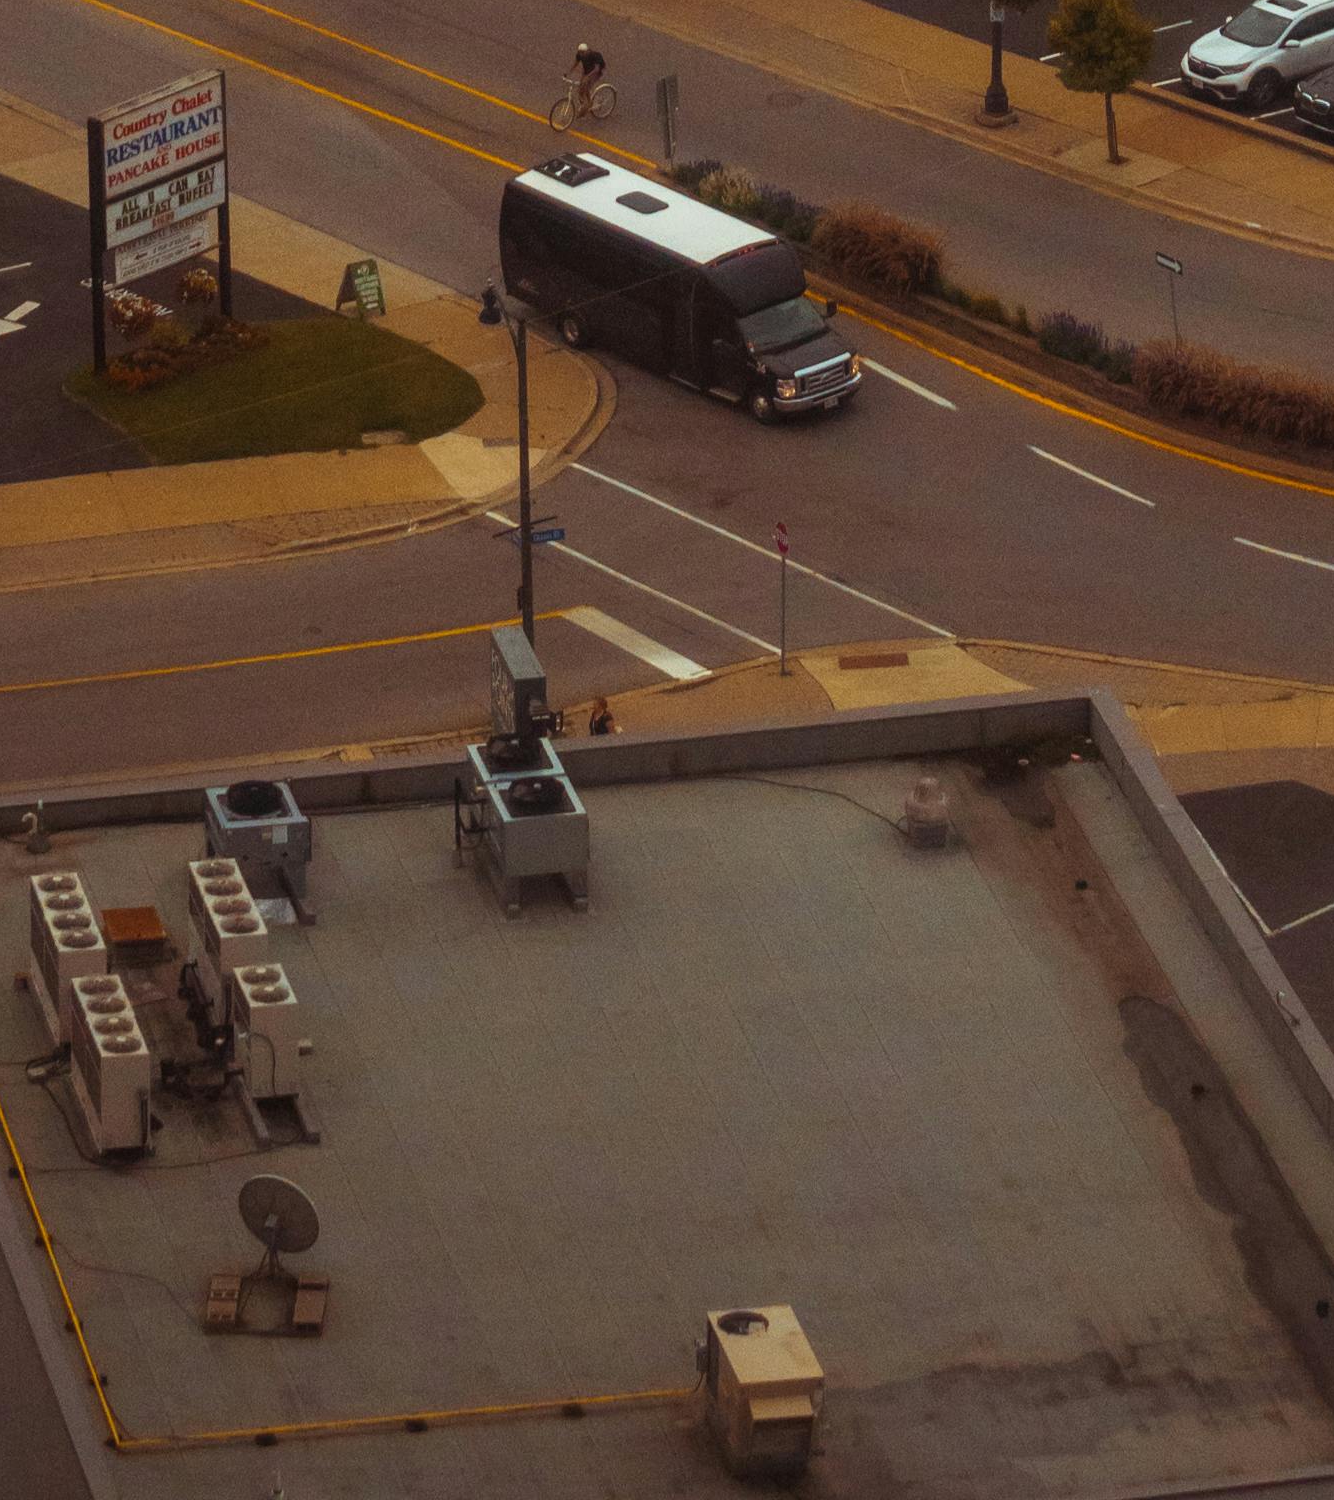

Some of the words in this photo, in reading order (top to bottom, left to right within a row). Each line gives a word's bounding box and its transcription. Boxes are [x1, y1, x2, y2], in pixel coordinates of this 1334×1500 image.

[106, 105, 222, 168] RESTAURANT
[113, 108, 167, 140] Country
[171, 89, 213, 116] Chalet
[107, 152, 170, 188] PANCAKE
[175, 132, 220, 161] HOUSE
[115, 199, 172, 231] BREAKFAST
[178, 182, 214, 206] BUFFET
[121, 198, 139, 215] ALL
[147, 190, 155, 203] U
[168, 176, 188, 195] CAN
[197, 166, 216, 184] EAT
